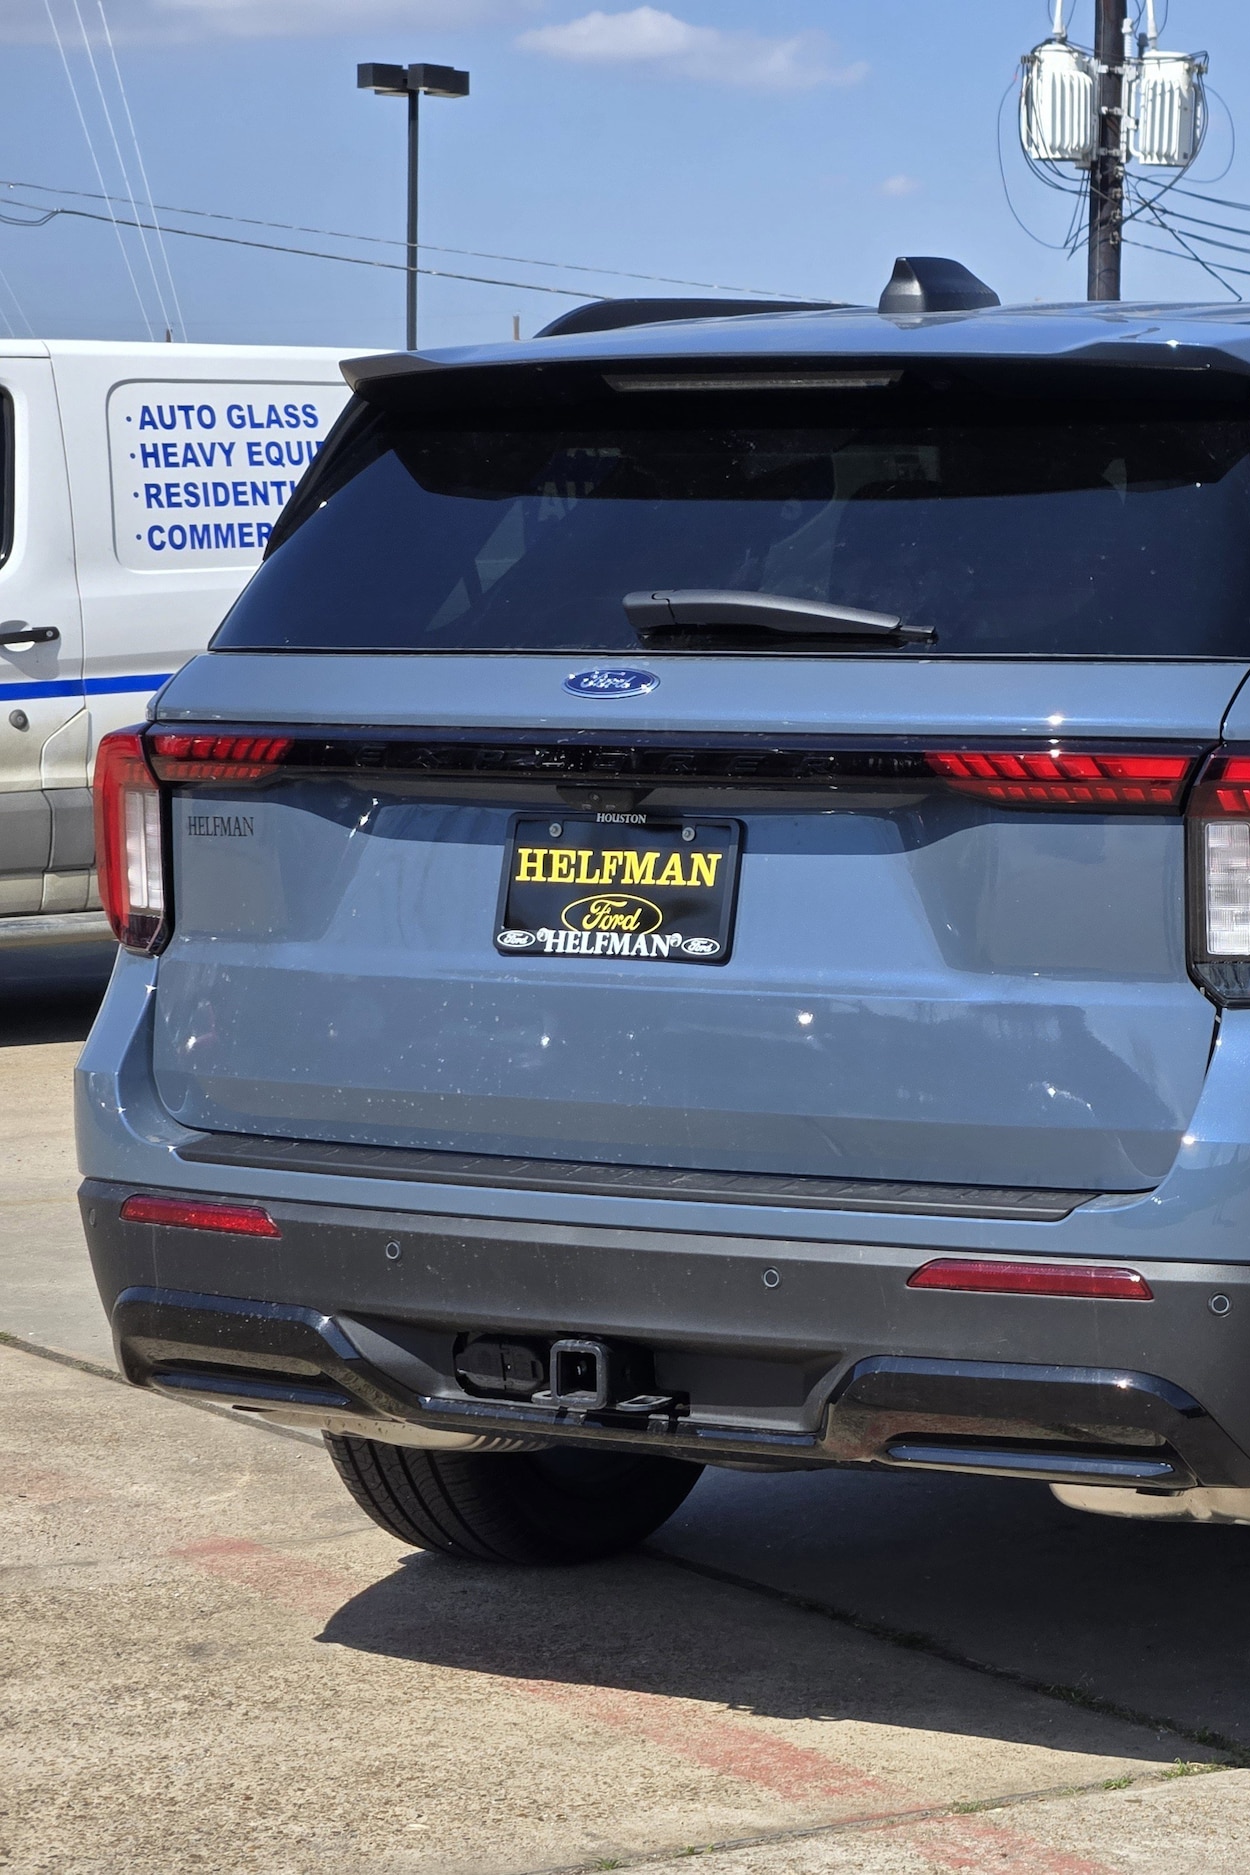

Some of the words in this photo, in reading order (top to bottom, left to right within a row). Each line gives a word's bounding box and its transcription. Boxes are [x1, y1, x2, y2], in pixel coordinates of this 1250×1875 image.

[139, 405, 216, 430] AUTO
[227, 404, 319, 429] GLASS
[140, 441, 236, 468] HEAVY
[147, 522, 273, 551] COMMER
[580, 671, 637, 689] Ford
[187, 815, 255, 837] HELFMAN
[595, 812, 647, 825] HOUSTON
[515, 848, 722, 888] HELFMAN
[582, 899, 643, 931] Ford
[502, 932, 528, 945] Ford
[542, 928, 675, 958] HELFMAN
[689, 940, 716, 954] Ford
